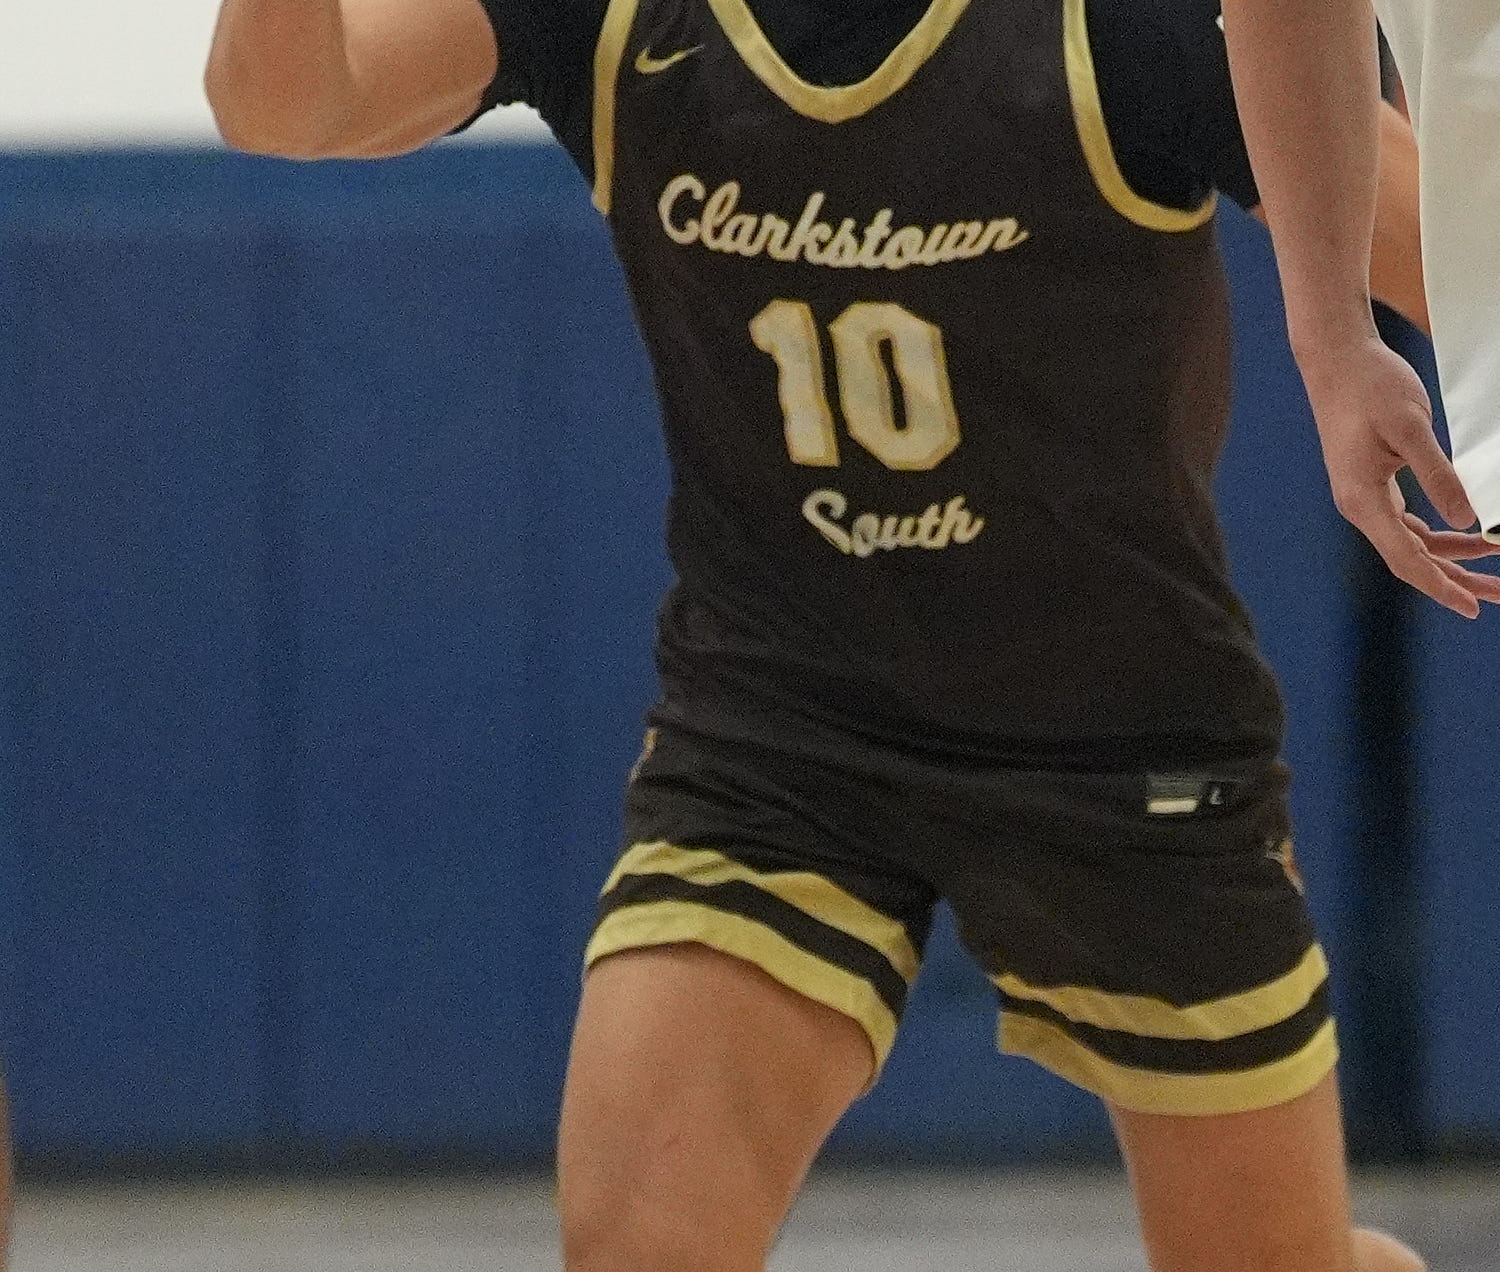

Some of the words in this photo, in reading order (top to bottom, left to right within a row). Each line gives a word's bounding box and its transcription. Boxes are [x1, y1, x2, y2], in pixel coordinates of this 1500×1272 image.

[658, 174, 1029, 270] Clarkstown
[749, 299, 962, 471] 10
[802, 488, 986, 558] South
